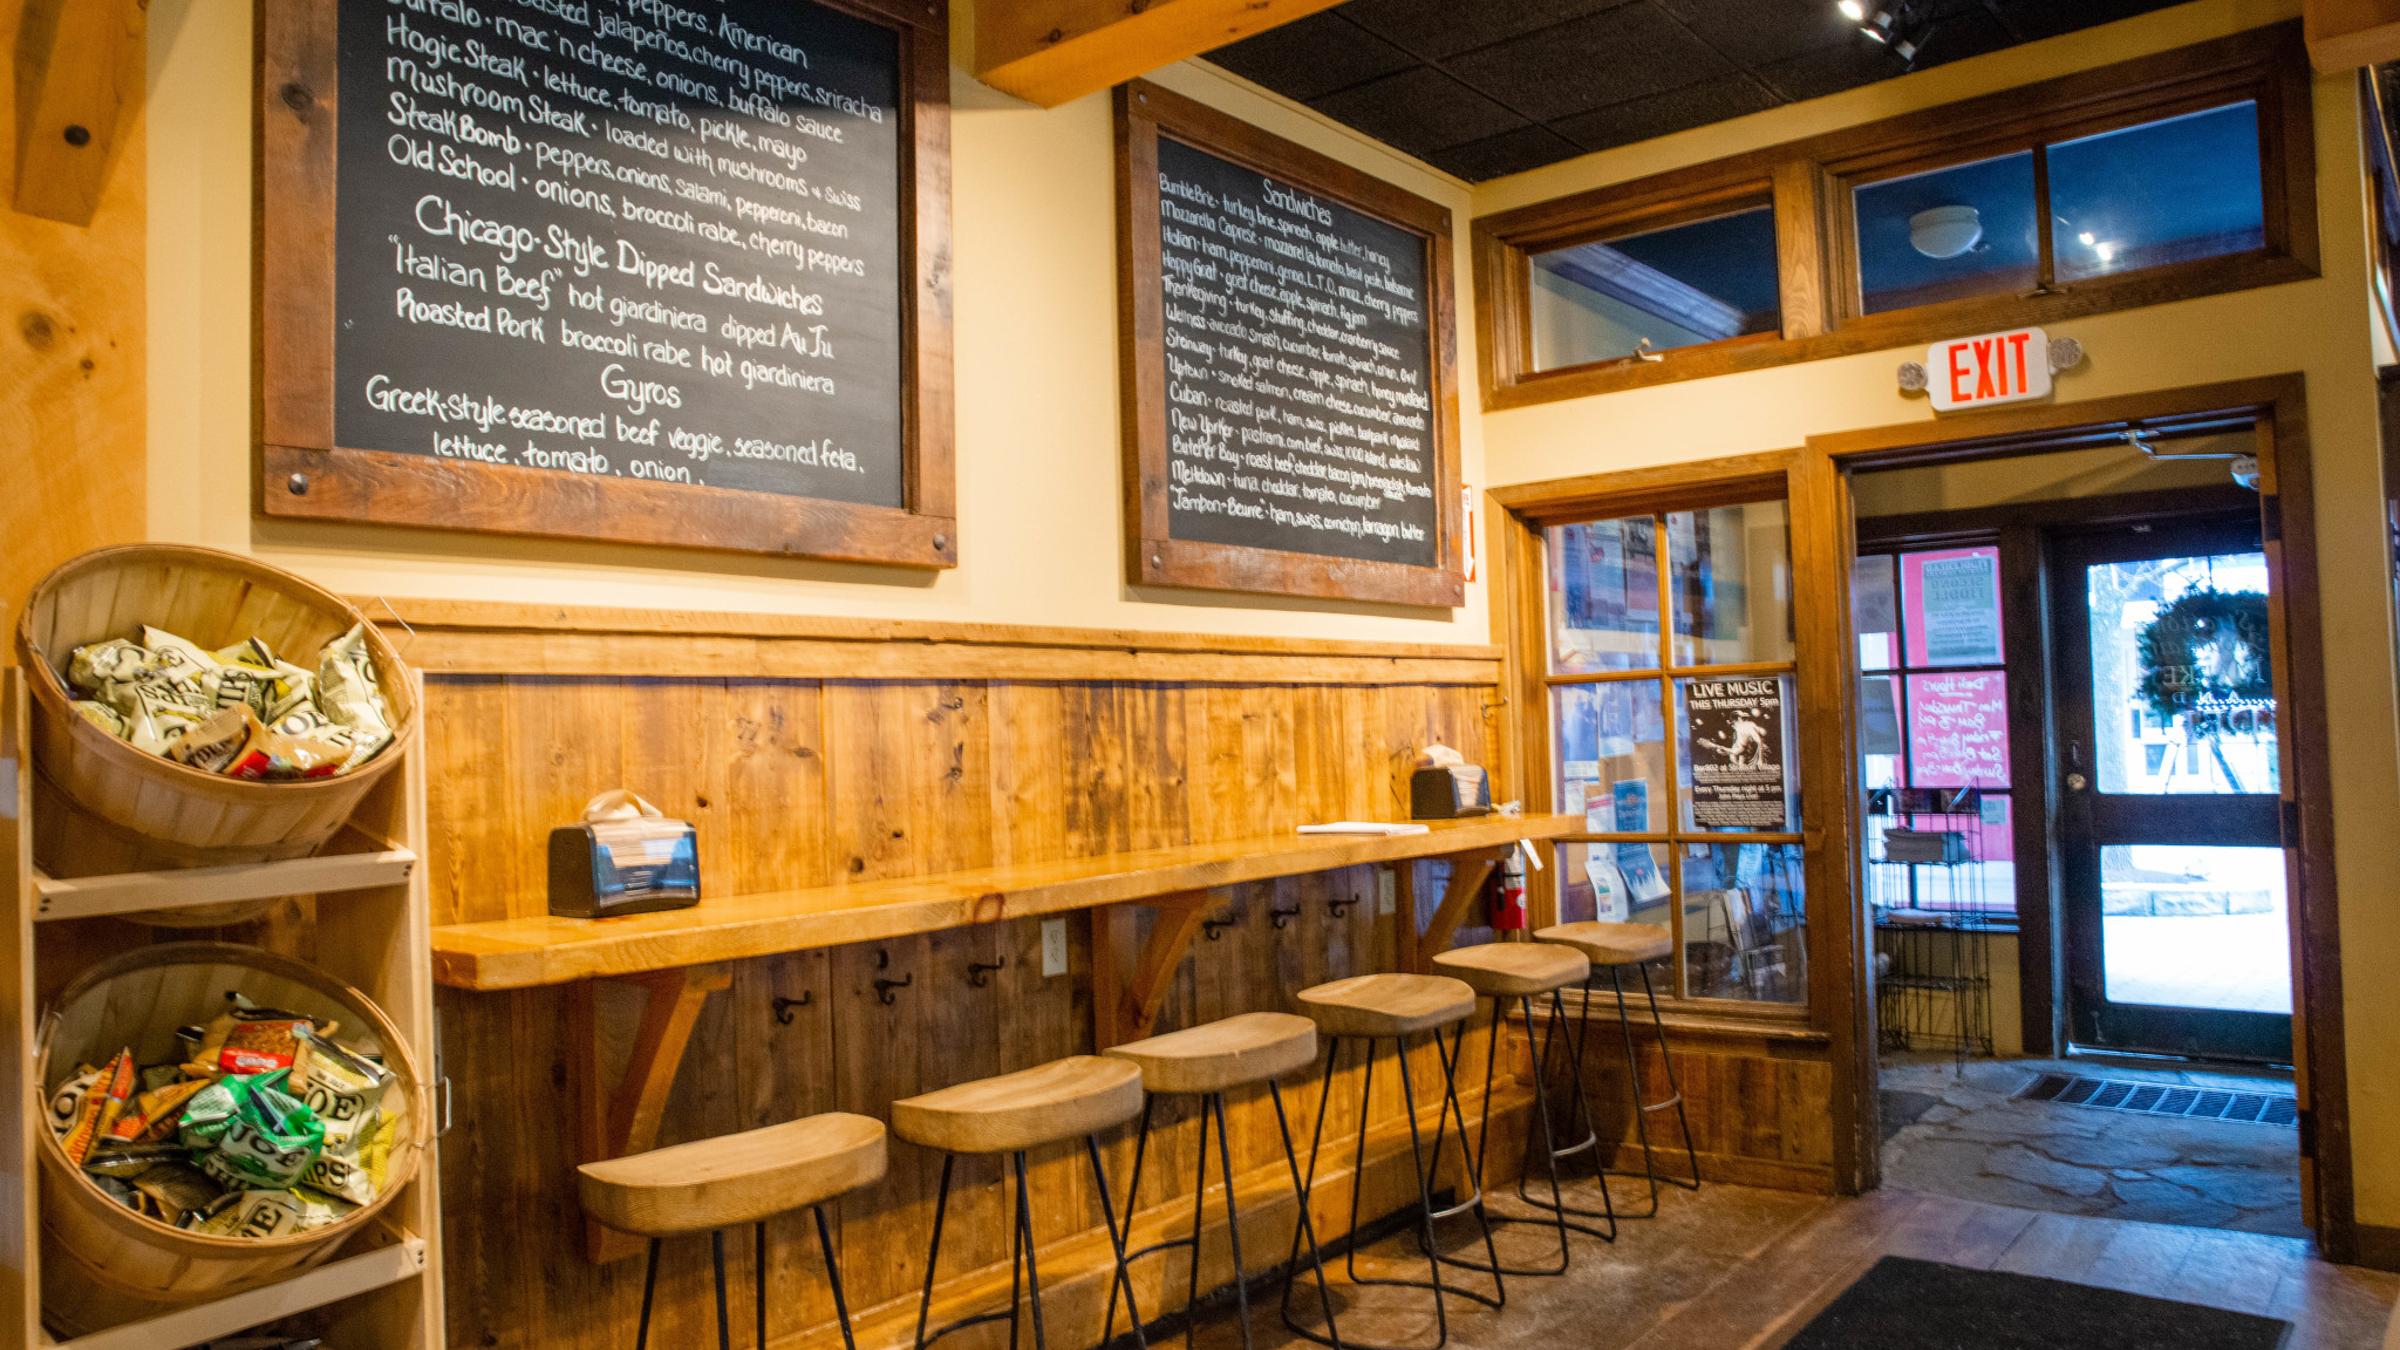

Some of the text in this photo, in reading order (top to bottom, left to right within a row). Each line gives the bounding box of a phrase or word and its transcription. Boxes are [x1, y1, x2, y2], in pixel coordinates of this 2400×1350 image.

[718, 13, 808, 69] American
[387, 13, 461, 68] Hogie
[464, 39, 529, 88] Steak
[758, 135, 808, 170] mayo
[496, 15, 551, 51] mac
[729, 87, 791, 127] buffalo
[796, 115, 844, 144] sauce
[693, 46, 750, 89] cherry
[815, 87, 883, 125] sriracha
[529, 94, 591, 138] Steak
[605, 119, 668, 158] loaded
[673, 145, 717, 176] with
[718, 157, 808, 197] mushrooms
[460, 113, 522, 155] Bomb
[807, 211, 848, 239] bacon
[1263, 178, 1332, 227] Sandwiches
[387, 133, 435, 171] Old
[437, 144, 516, 192] School
[622, 196, 695, 235] broccoli
[750, 231, 803, 270] cherry
[808, 248, 865, 277] peppers
[1160, 199, 1216, 232] Mozzarella
[616, 239, 696, 290] Dipped
[703, 262, 824, 317] Sandwiches
[1162, 225, 1198, 252] Italian
[1364, 291, 1391, 320] cherry
[1392, 304, 1419, 327] peppers
[1225, 272, 1248, 295] goat
[1364, 245, 1391, 275] honey
[396, 287, 835, 396] Roasted Pork broccoli rabe hot giardiniera
[568, 283, 604, 313] hot
[610, 297, 708, 333] giardiniera
[721, 314, 776, 349] dipped
[780, 322, 807, 354] Au
[808, 325, 835, 360] Ju
[1160, 274, 1228, 318] Thanksgiving
[1339, 331, 1378, 360] cranberry
[1378, 341, 1400, 360] sauce
[1165, 302, 1206, 330] Wellness
[1208, 318, 1247, 338] avocado
[600, 363, 683, 415] Gyros
[1165, 327, 1213, 364] Steinway
[1252, 354, 1275, 377] goat
[1371, 380, 1397, 409] honey
[1395, 388, 1429, 412] mustard
[1166, 352, 1208, 381] Uptown
[1218, 370, 1254, 391] smoked
[1293, 387, 1325, 405] cream
[1948, 332, 2030, 403] EXIT
[1169, 380, 1209, 408] Cuban
[1214, 396, 1254, 417] roasted
[1170, 407, 1199, 434] New
[1198, 413, 1234, 444] Yorker
[509, 406, 606, 440] seasoned
[615, 415, 660, 446] beef
[734, 436, 818, 467] seasoned
[1172, 434, 1216, 460] Butcher
[1218, 441, 1240, 470] Boy
[1245, 451, 1273, 471] roast
[1172, 460, 1226, 489] Meltdown
[1339, 492, 1381, 511] cucumber
[1400, 520, 1425, 541] butter
[1690, 697, 1779, 710] THIS THURSDAY 5pm
[1693, 680, 1774, 698] LIVE MUSIC
